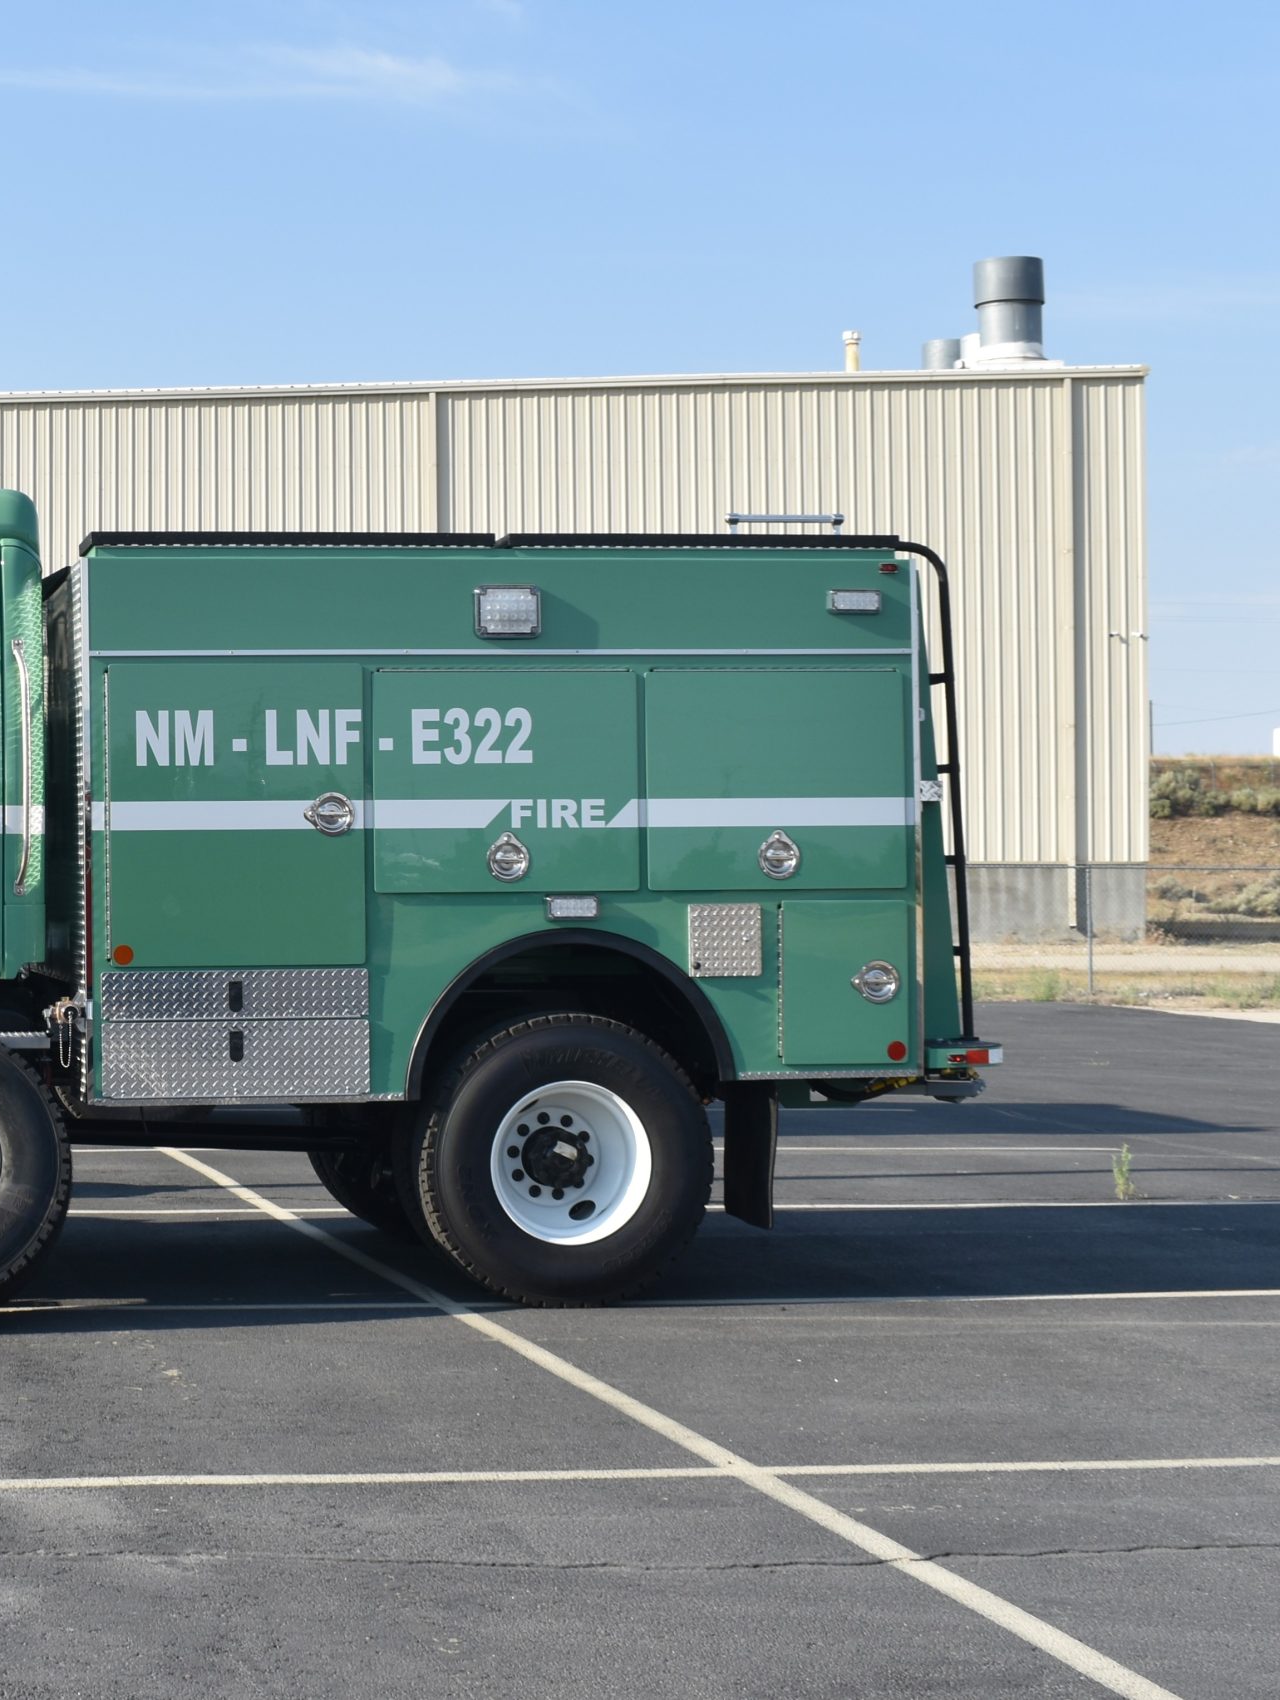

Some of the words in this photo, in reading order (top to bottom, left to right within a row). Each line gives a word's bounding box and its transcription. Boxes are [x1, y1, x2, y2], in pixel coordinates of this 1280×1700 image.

[136, 709, 214, 767] NM
[266, 708, 362, 766] LNF
[412, 707, 533, 765] E322
[511, 799, 607, 828] FIRE
